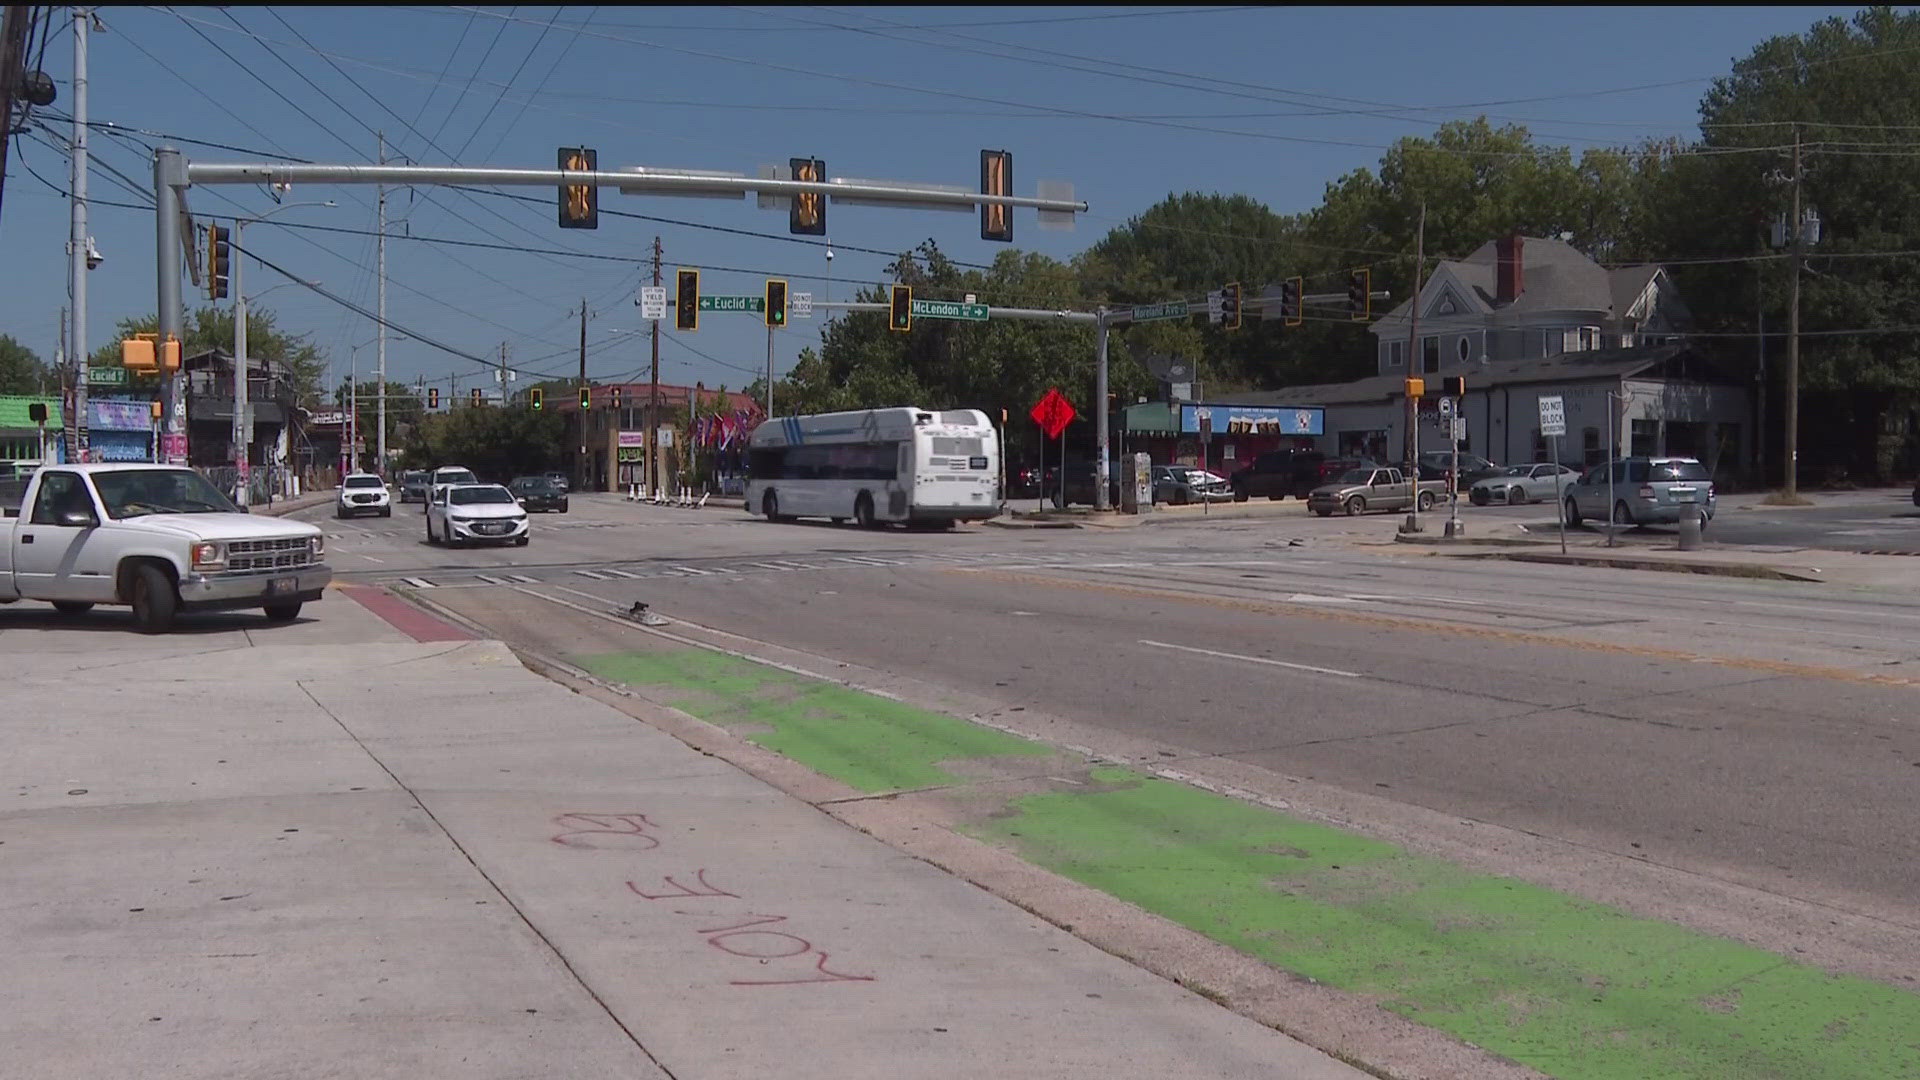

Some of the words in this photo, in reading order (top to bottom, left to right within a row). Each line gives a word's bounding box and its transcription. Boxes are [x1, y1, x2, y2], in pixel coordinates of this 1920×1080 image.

[714, 297, 746, 309] Euclid
[913, 301, 959, 316] McLendon
[1134, 305, 1164, 319] Moreland
[1165, 305, 1179, 316] Ave
[90, 369, 117, 381] Euclid
[1541, 402, 1550, 412] DO
[1550, 401, 1562, 411] NOT
[1541, 414, 1564, 424] BLOCK
